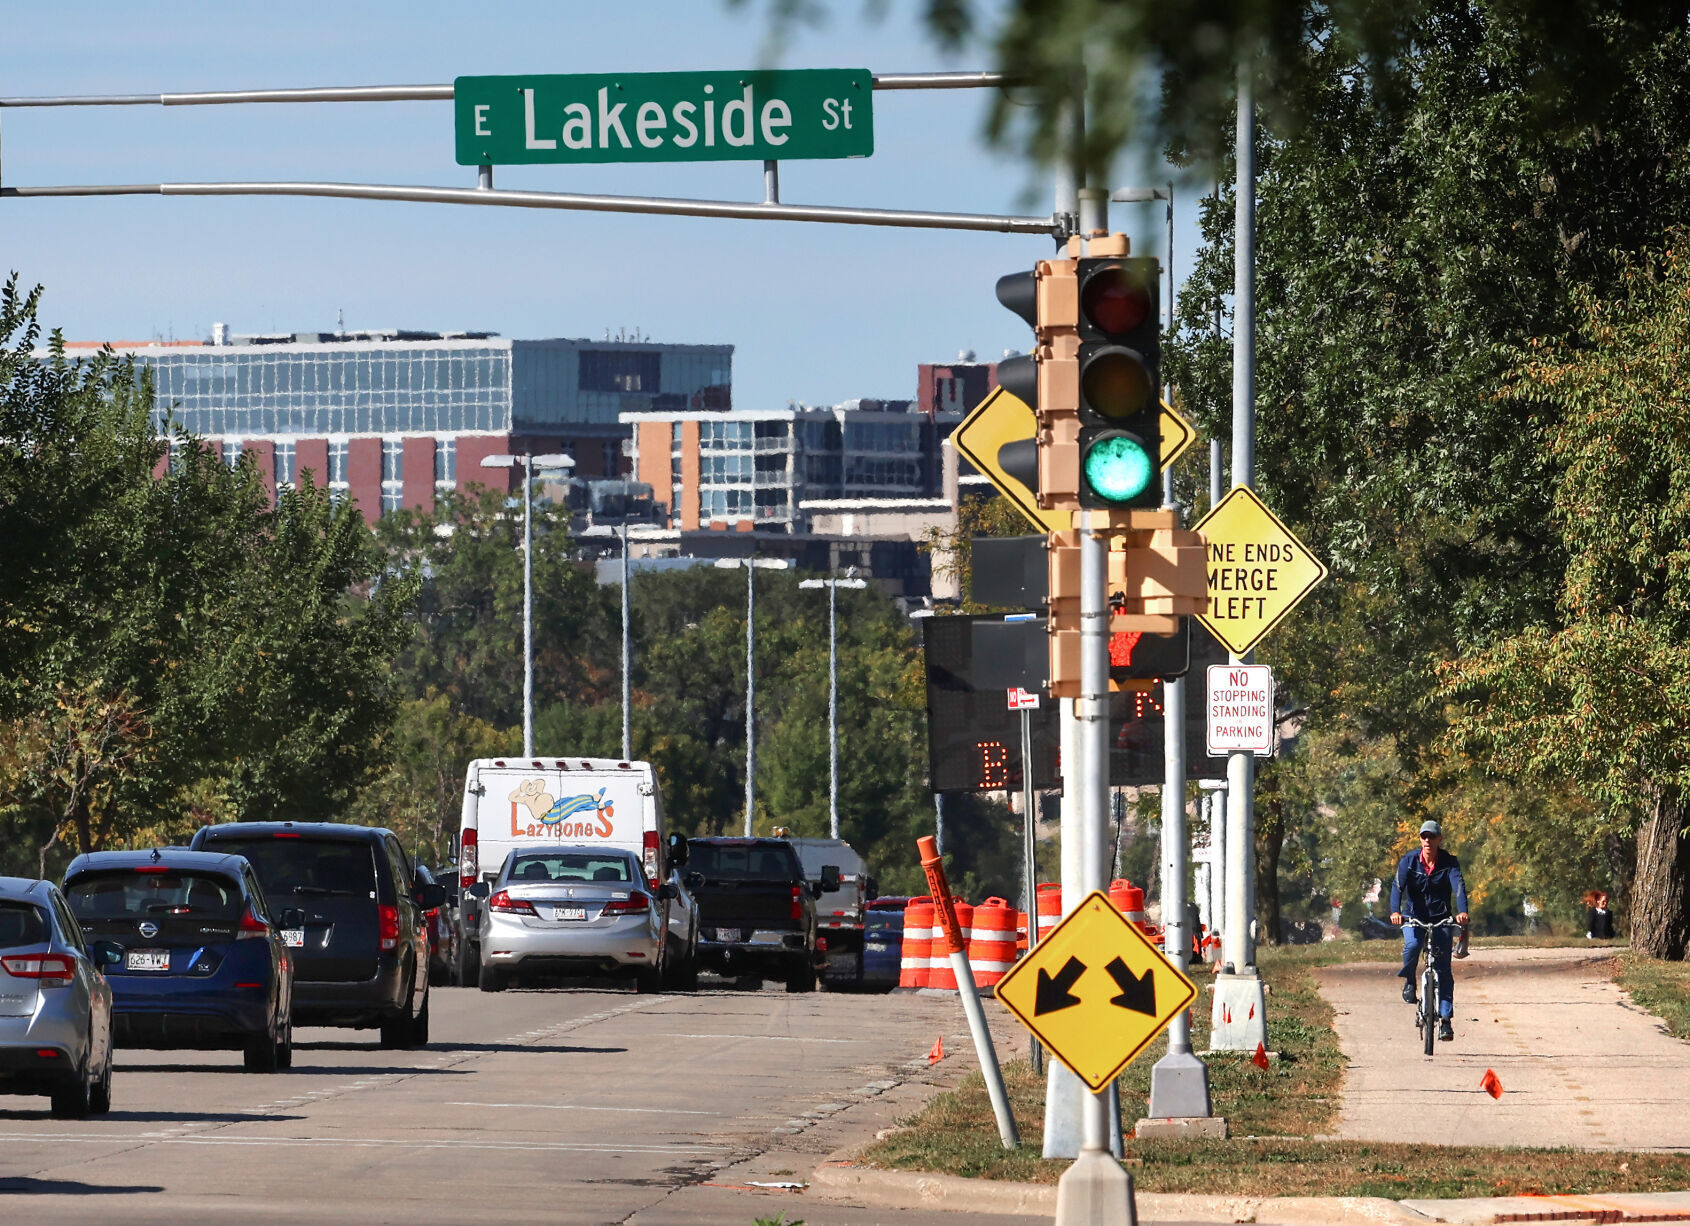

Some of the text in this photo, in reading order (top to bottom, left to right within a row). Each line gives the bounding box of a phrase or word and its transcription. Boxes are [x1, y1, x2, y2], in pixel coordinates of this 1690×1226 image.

[474, 84, 853, 149] E Lakeside St
[1207, 543, 1293, 562] NE ENDS
[1213, 597, 1266, 620] LEFT
[1229, 671, 1249, 687] NO
[1213, 690, 1266, 702] STOPPING
[1212, 705, 1266, 718] STANDING
[1216, 726, 1263, 738] PARKING
[976, 740, 1009, 789] B
